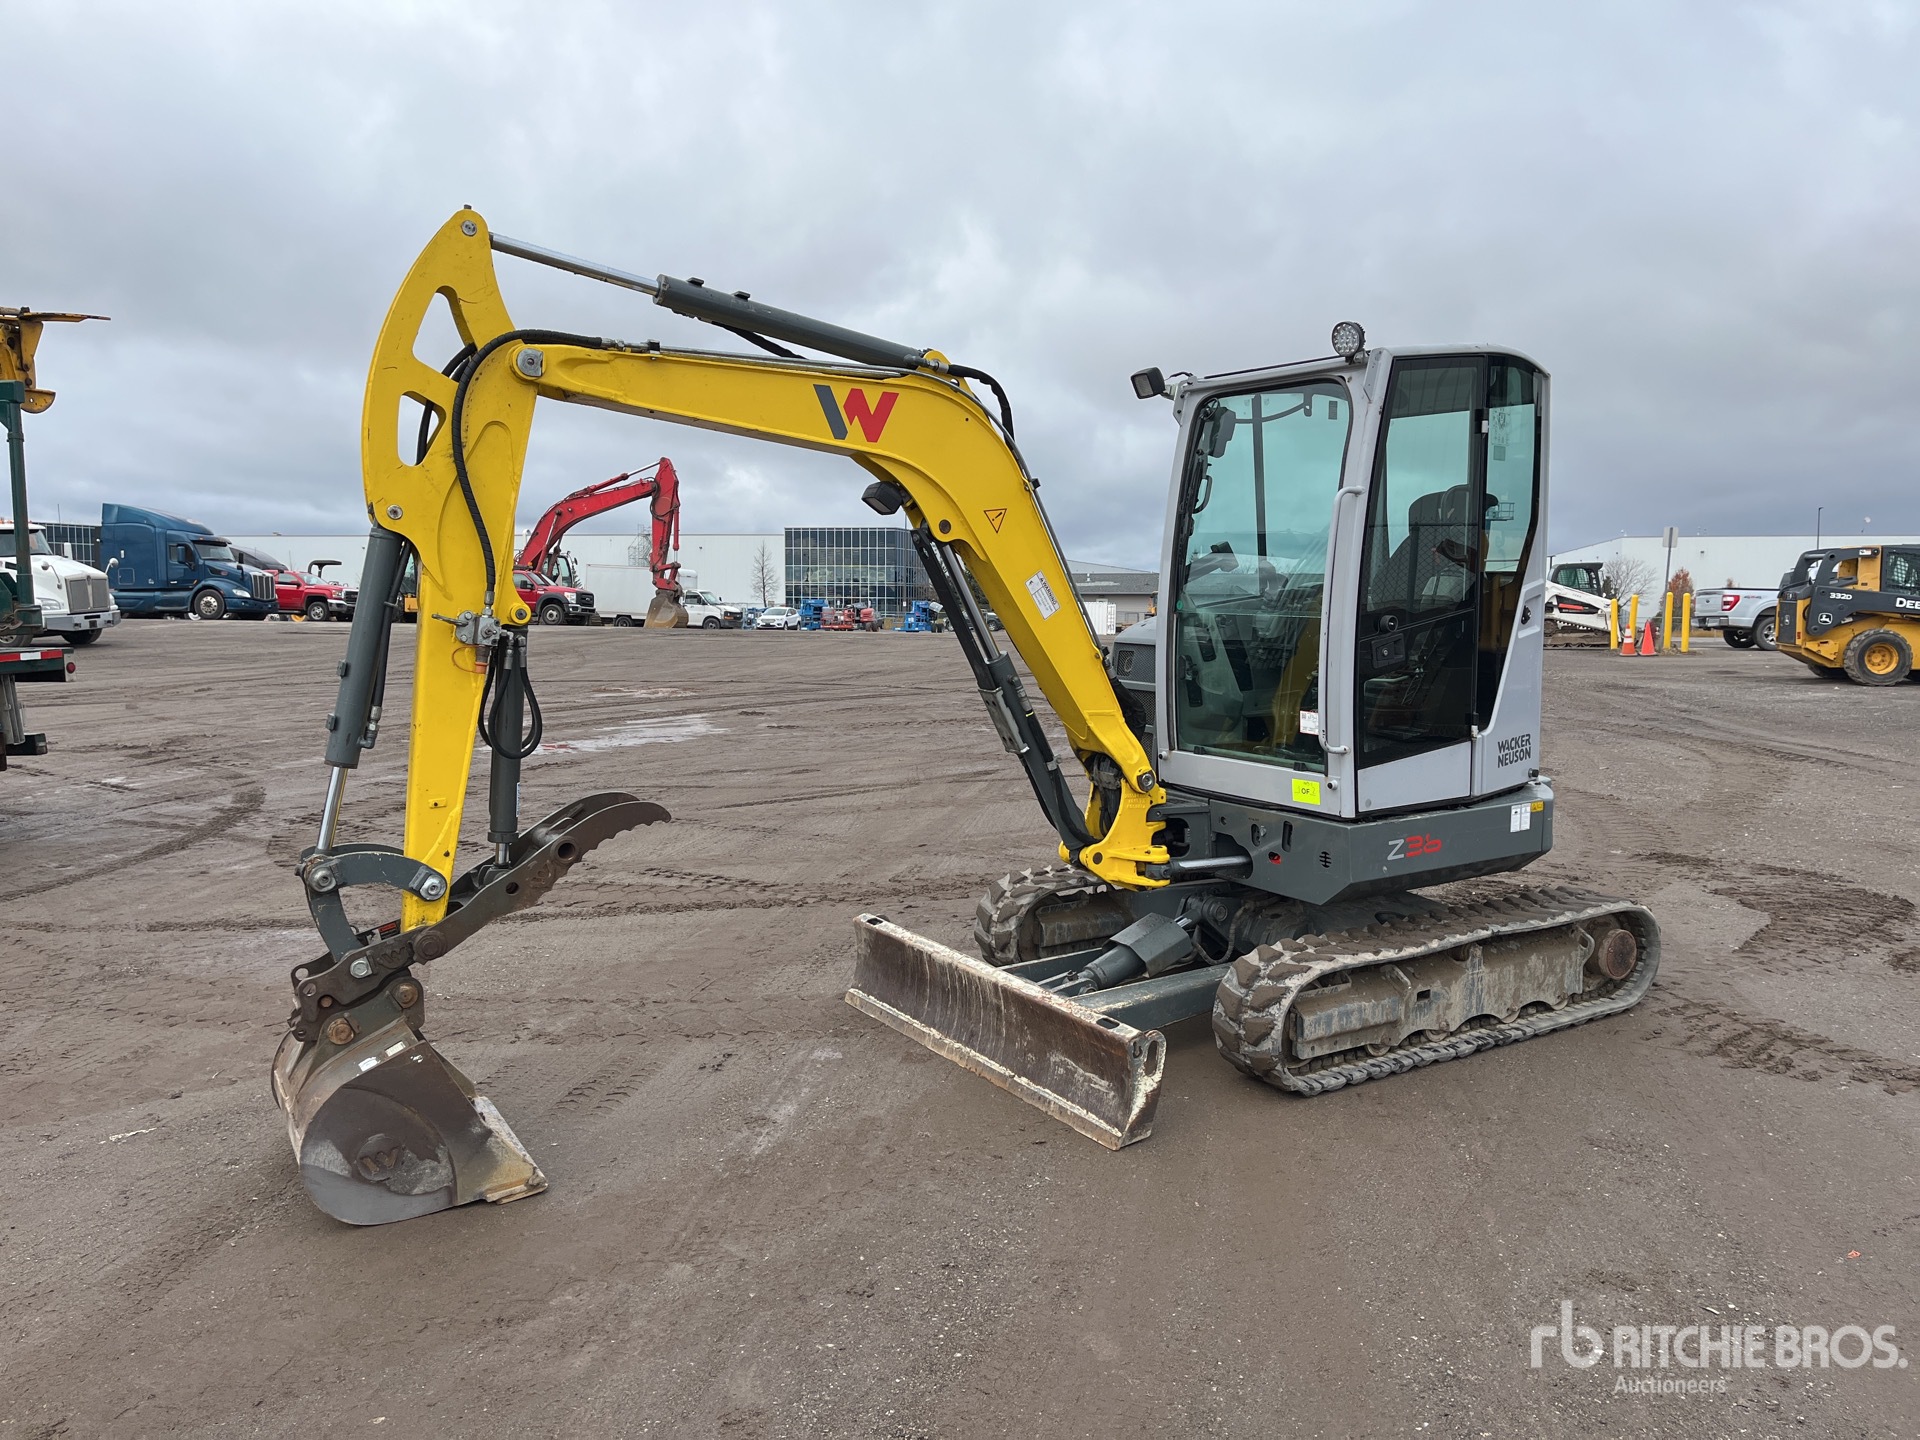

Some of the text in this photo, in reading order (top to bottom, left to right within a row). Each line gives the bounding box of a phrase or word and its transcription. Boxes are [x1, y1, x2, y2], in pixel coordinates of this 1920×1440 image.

[1829, 592, 1853, 601] 332D
[1497, 733, 1532, 754] WACKER
[1497, 746, 1532, 769] NEUSON
[1301, 787, 1310, 795] OF
[1387, 833, 1442, 861] Z36
